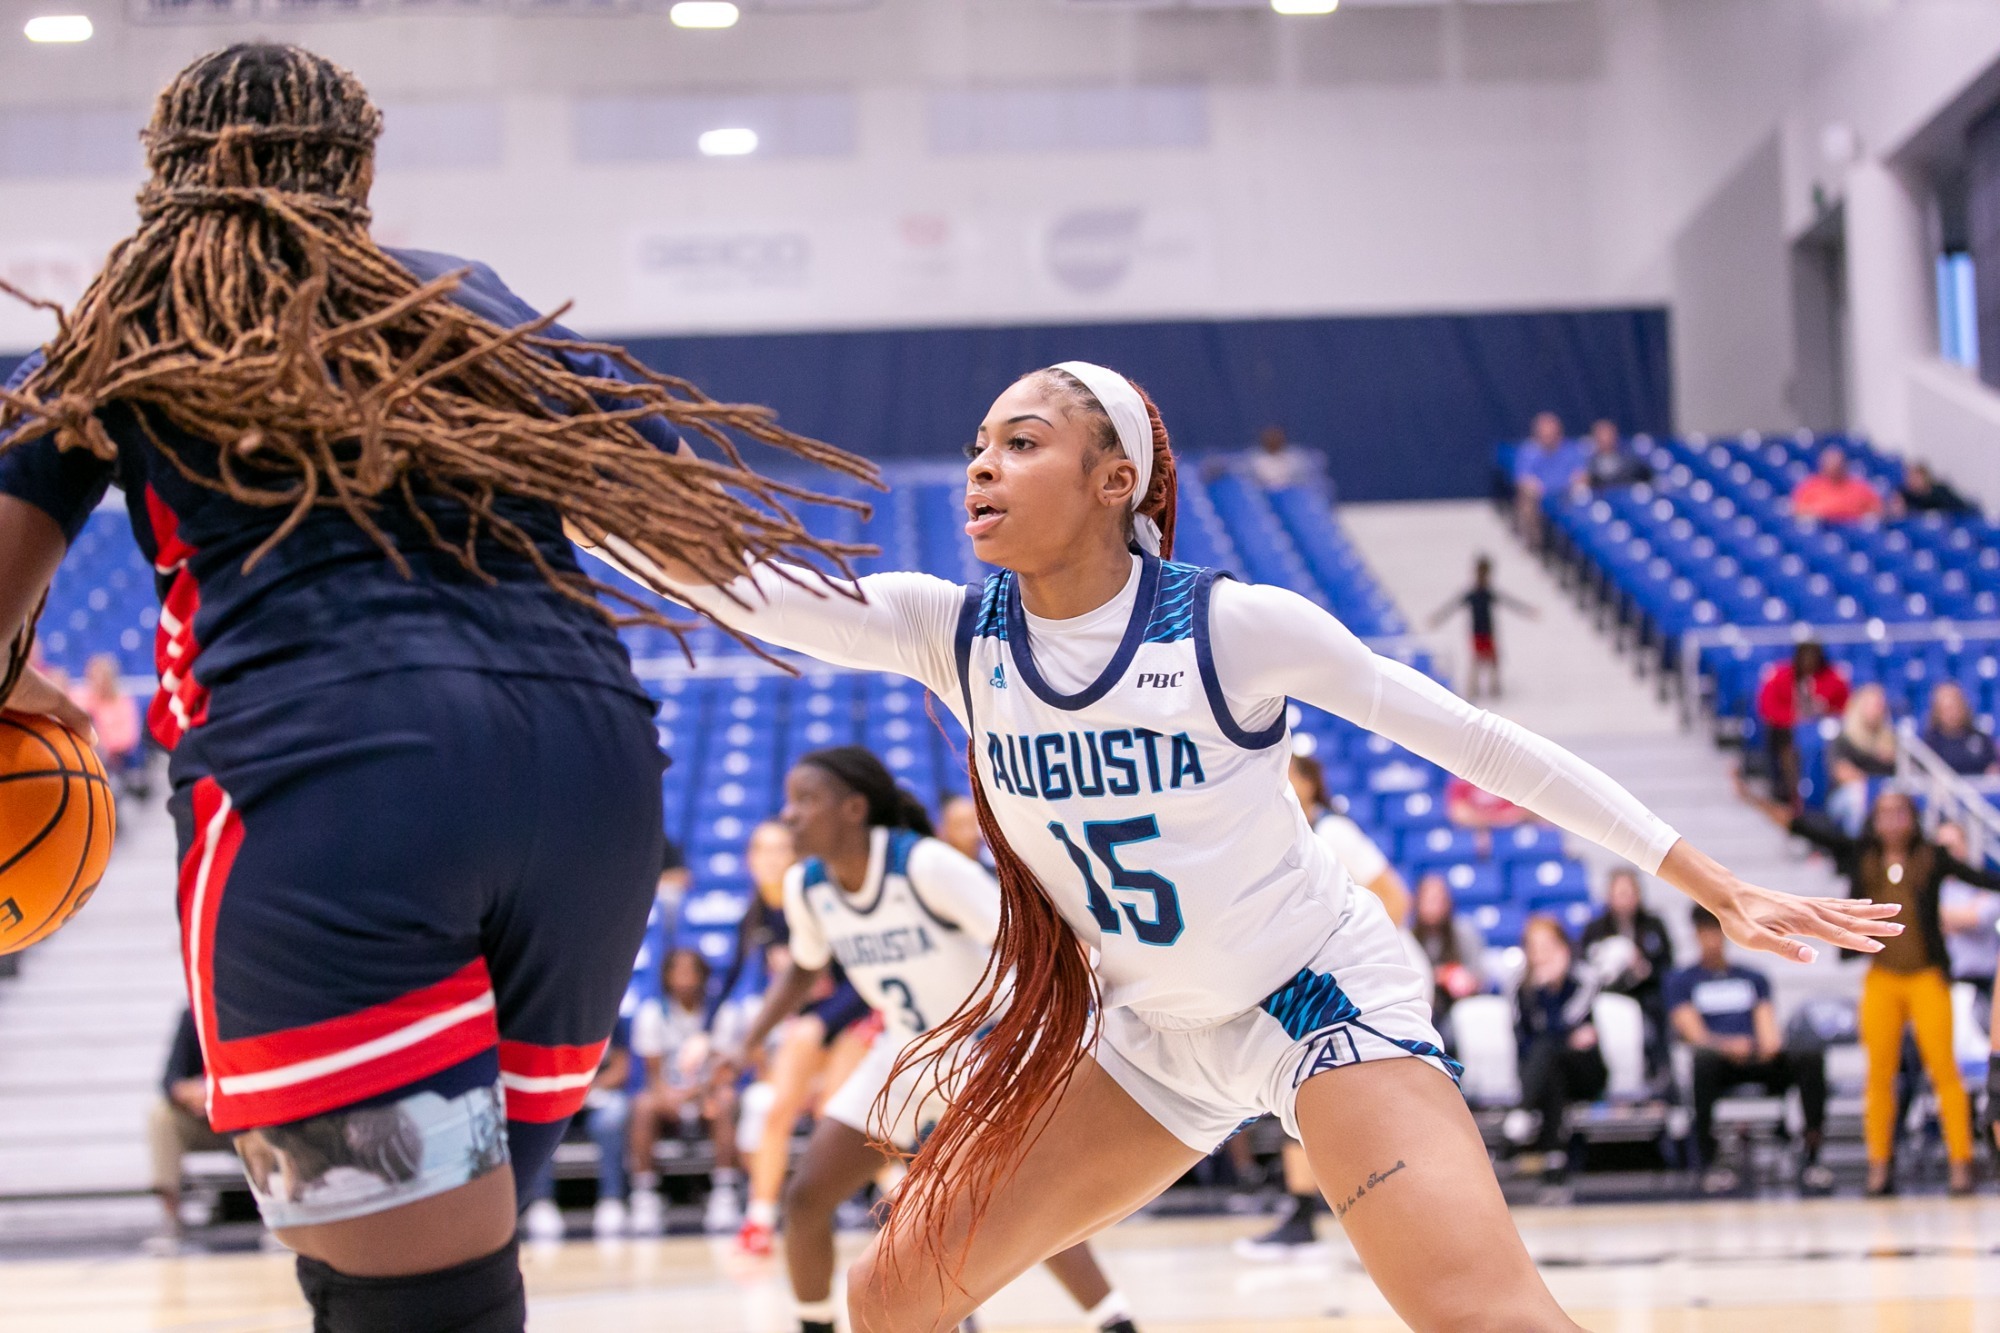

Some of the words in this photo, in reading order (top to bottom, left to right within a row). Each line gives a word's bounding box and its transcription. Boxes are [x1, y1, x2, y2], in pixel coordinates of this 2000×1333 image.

[1136, 670, 1185, 689] PBC
[986, 727, 1206, 801] AUGUSTA
[1046, 812, 1186, 947] 15
[879, 975, 927, 1033] 3
